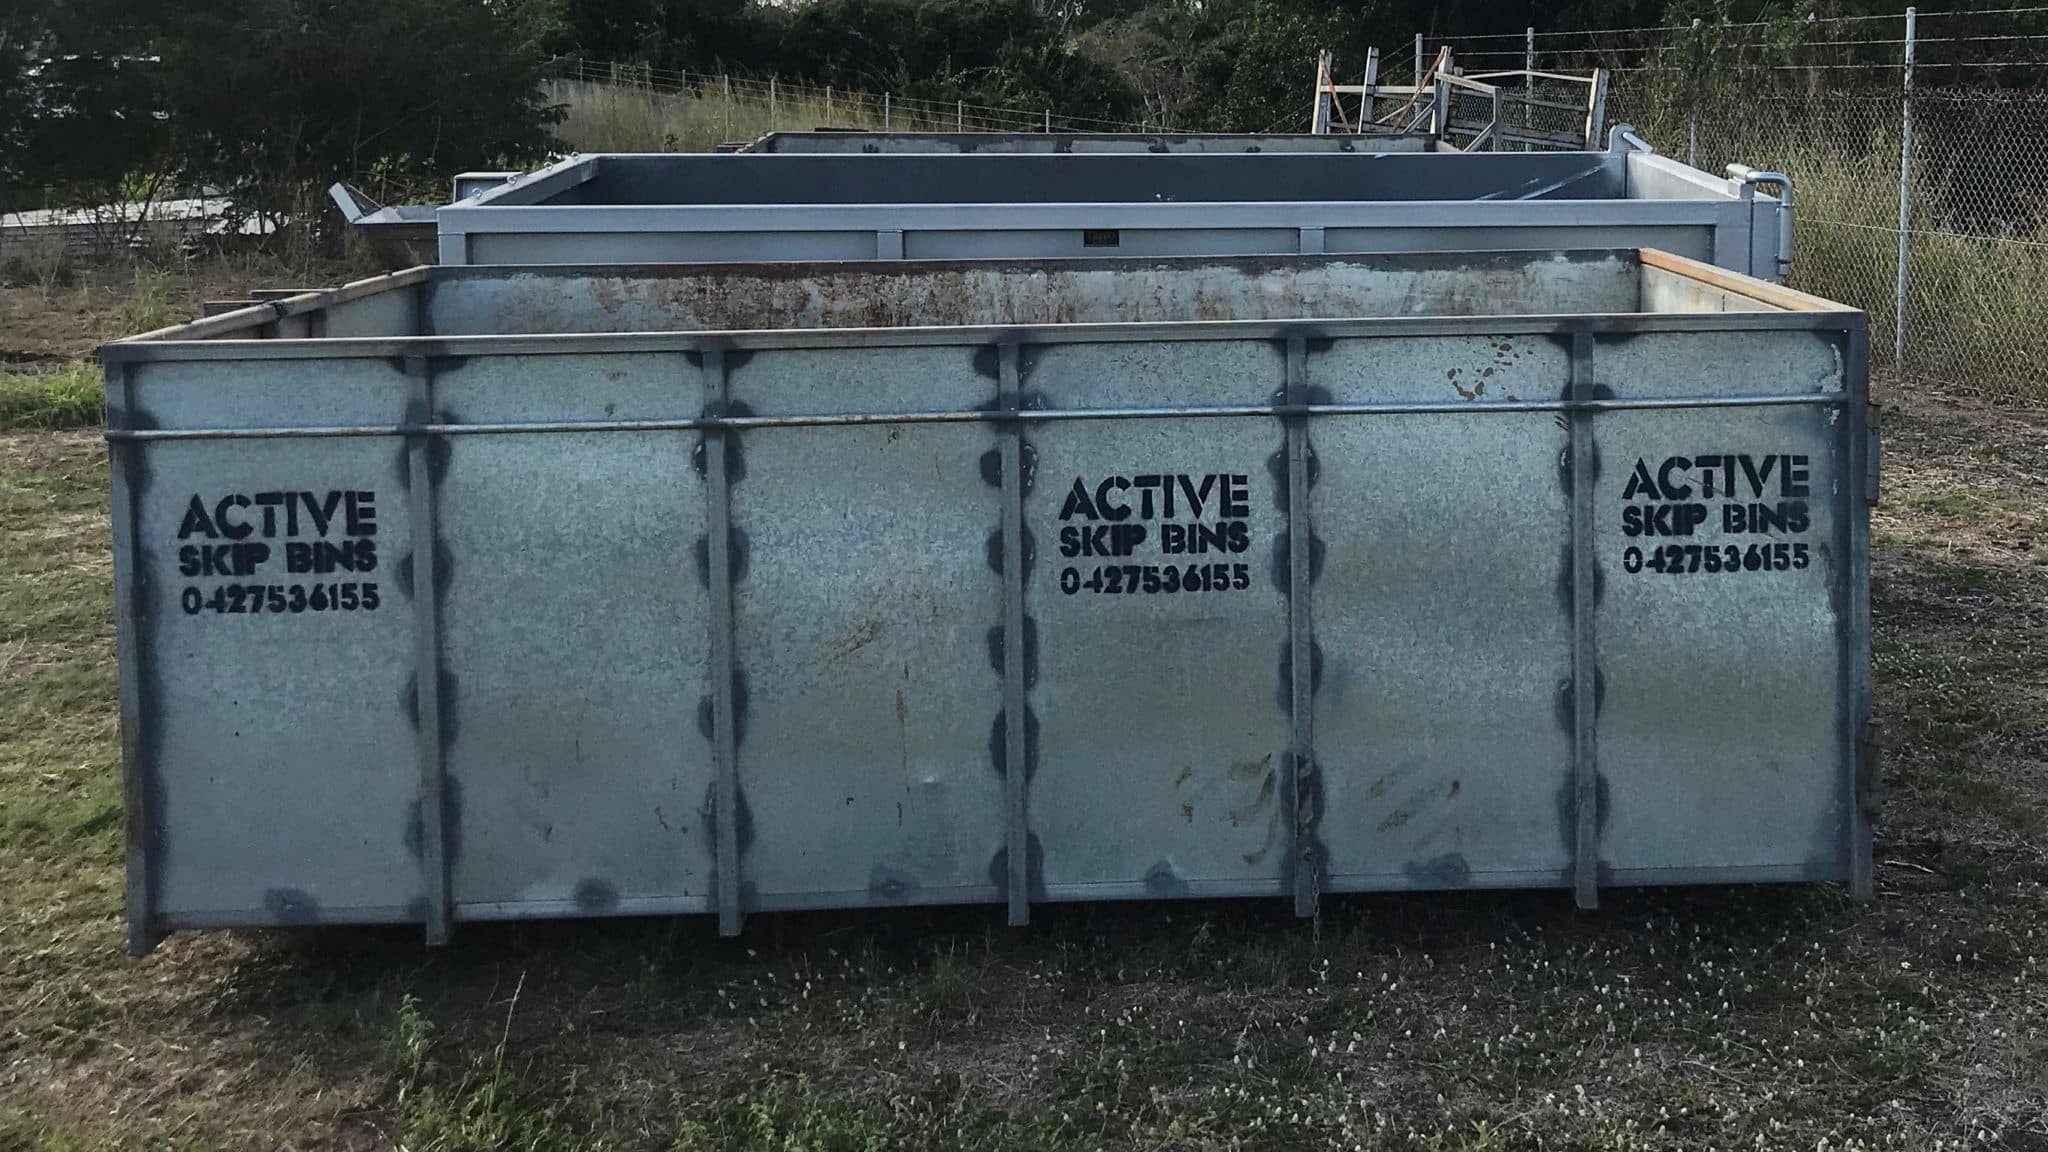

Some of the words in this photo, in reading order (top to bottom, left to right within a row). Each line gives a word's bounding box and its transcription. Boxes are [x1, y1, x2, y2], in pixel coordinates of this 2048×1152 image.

[1059, 474, 1249, 521] ACTIVE
[1622, 455, 1809, 500] ACTIVE
[177, 490, 377, 539] ACTIVE
[1622, 503, 1707, 537] SKIP
[1723, 501, 1809, 534] BINS
[179, 543, 270, 576] SKIP
[286, 539, 378, 573] BINS
[1060, 524, 1147, 557] SKIP
[1161, 521, 1249, 553] BINS
